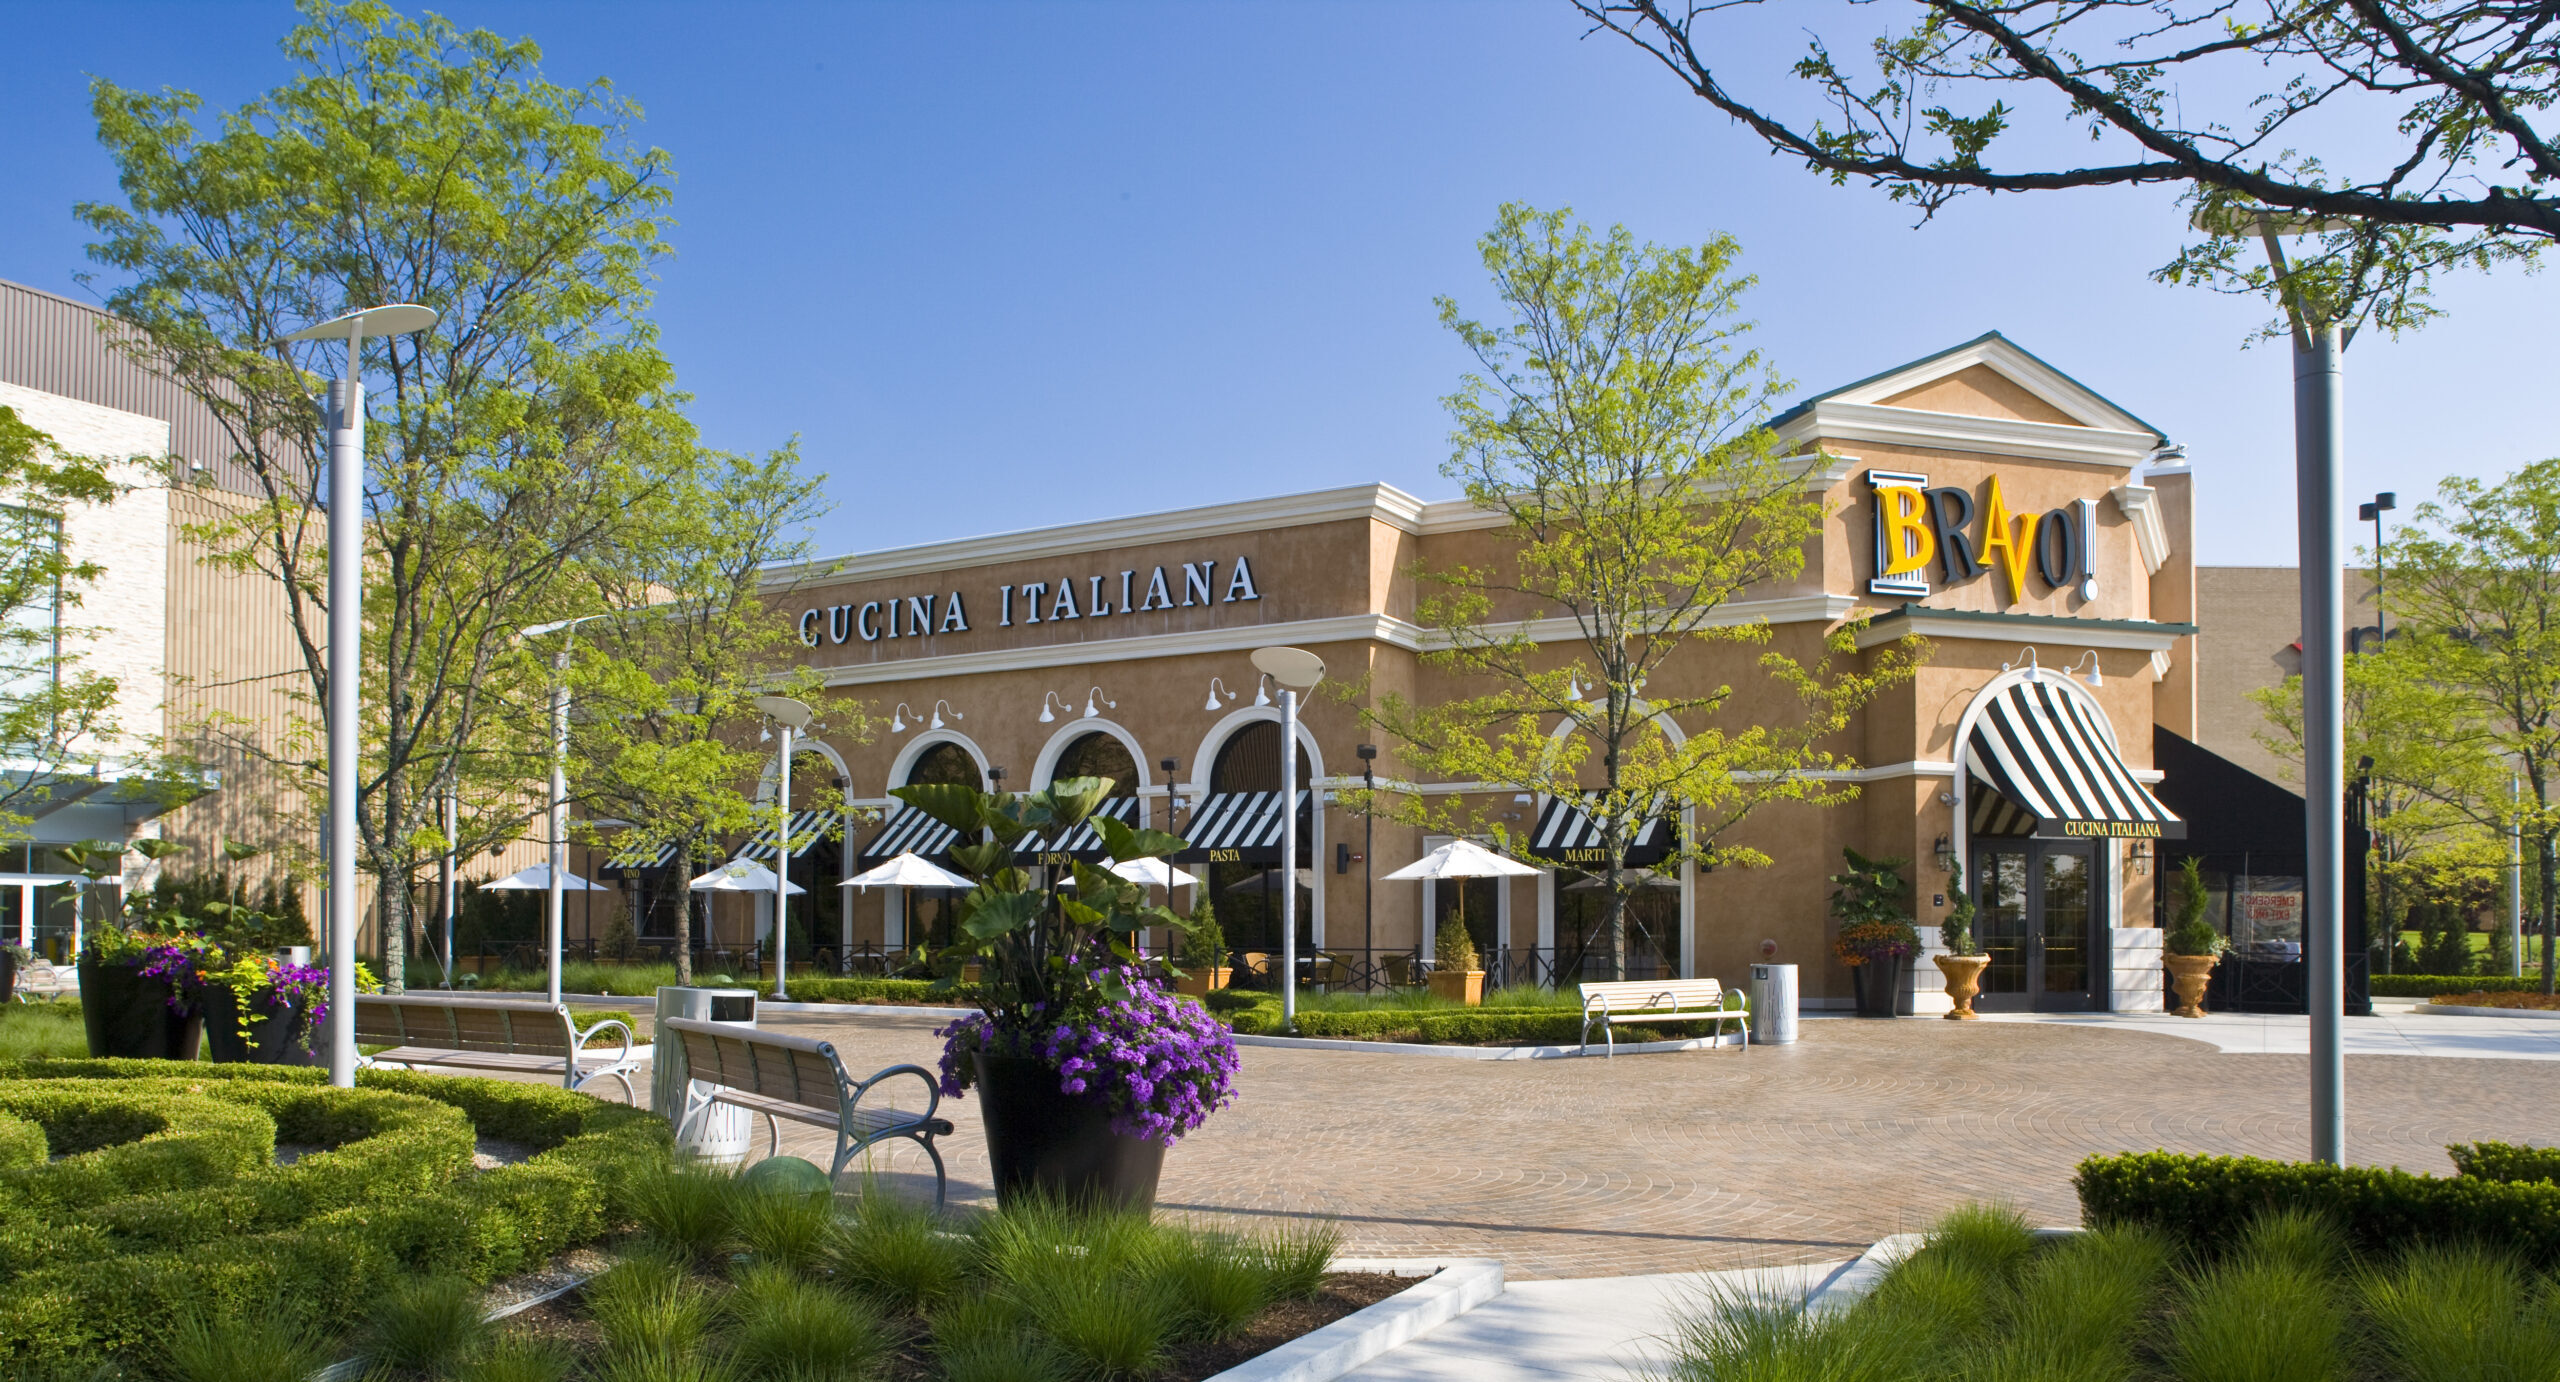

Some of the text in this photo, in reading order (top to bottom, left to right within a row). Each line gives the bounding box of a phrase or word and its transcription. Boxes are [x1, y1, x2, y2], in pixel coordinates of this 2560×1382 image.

[1871, 472, 2100, 605] BRAVO!
[798, 556, 1260, 648] CUCINA ITALIANA
[2065, 821, 2162, 837] CUCINA ITALIANA
[1210, 849, 1240, 862] PASTA
[1565, 848, 1607, 862] MARTI
[623, 868, 640, 879] VINO
